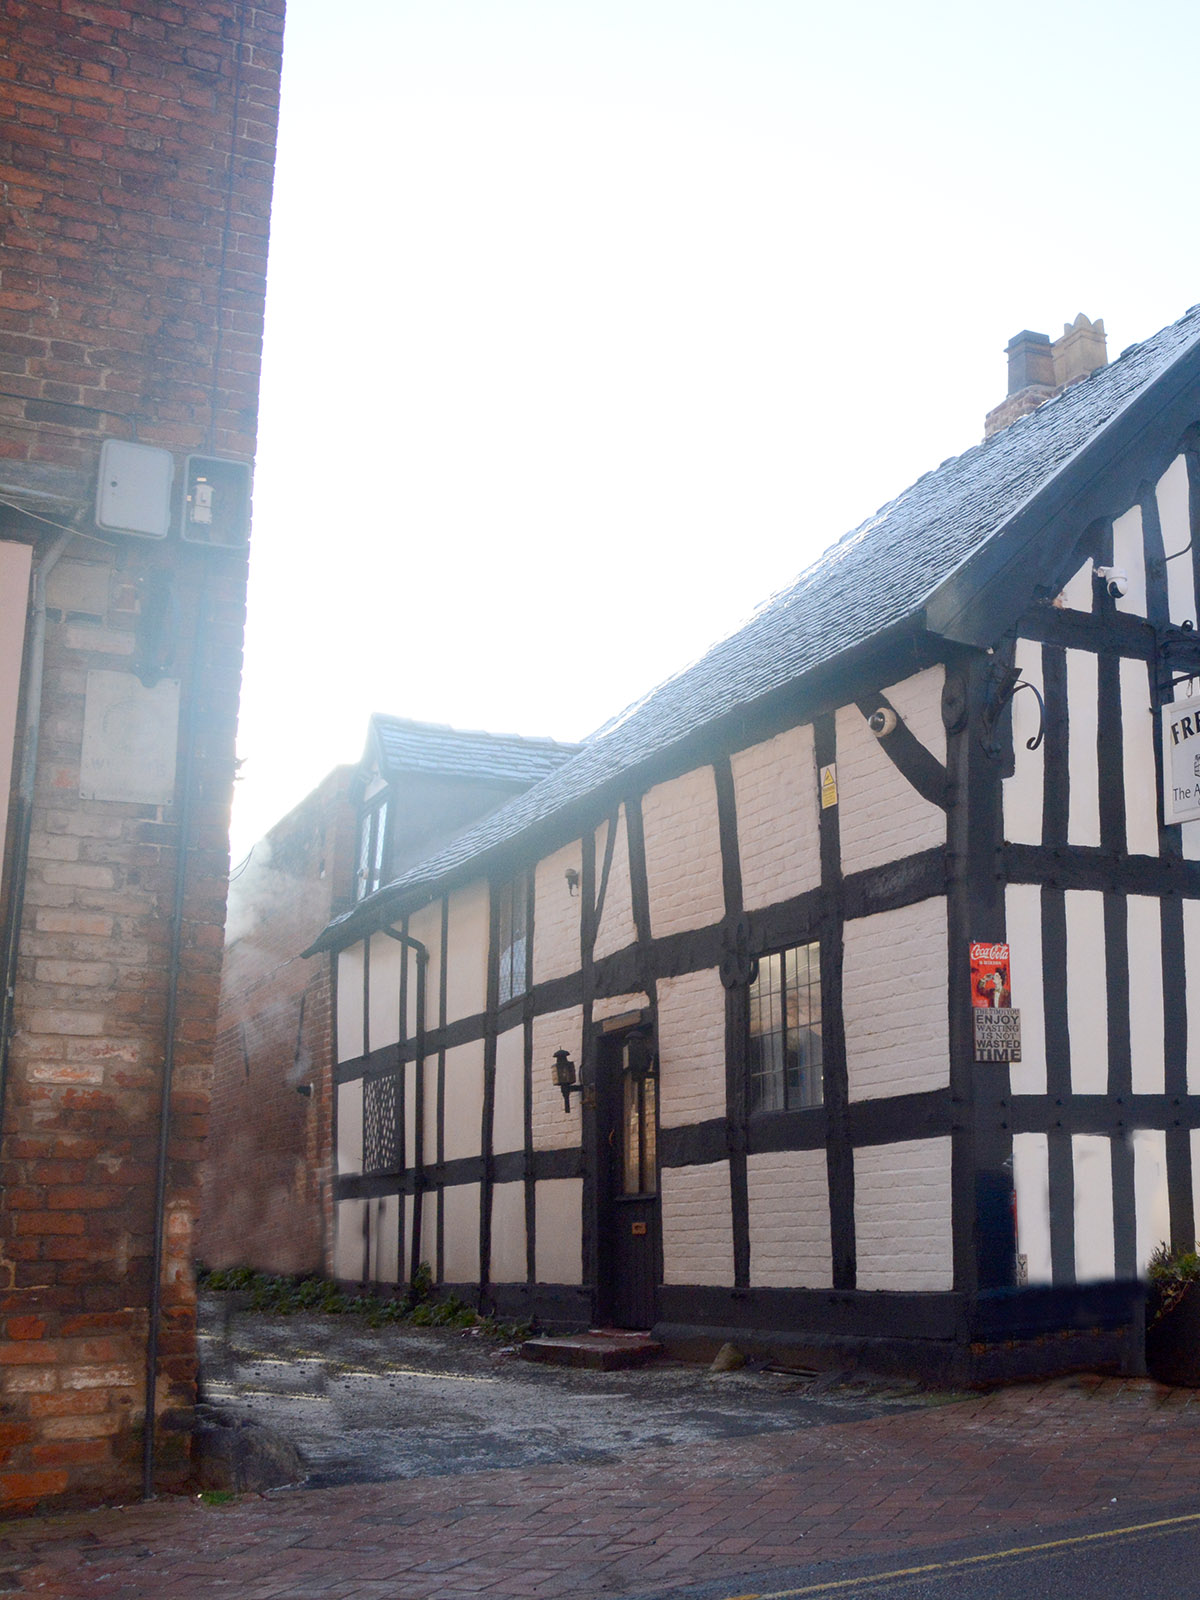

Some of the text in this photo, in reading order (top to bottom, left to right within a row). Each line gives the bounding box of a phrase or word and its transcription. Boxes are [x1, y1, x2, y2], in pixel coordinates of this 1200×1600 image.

[1173, 786, 1191, 801] The
[976, 1015, 1019, 1025] ENJOY
[976, 1024, 1019, 1032] WASTING
[981, 1032, 1016, 1040] IS NOT
[976, 1040, 1021, 1049] WASTED
[976, 1049, 1021, 1061] TIME
